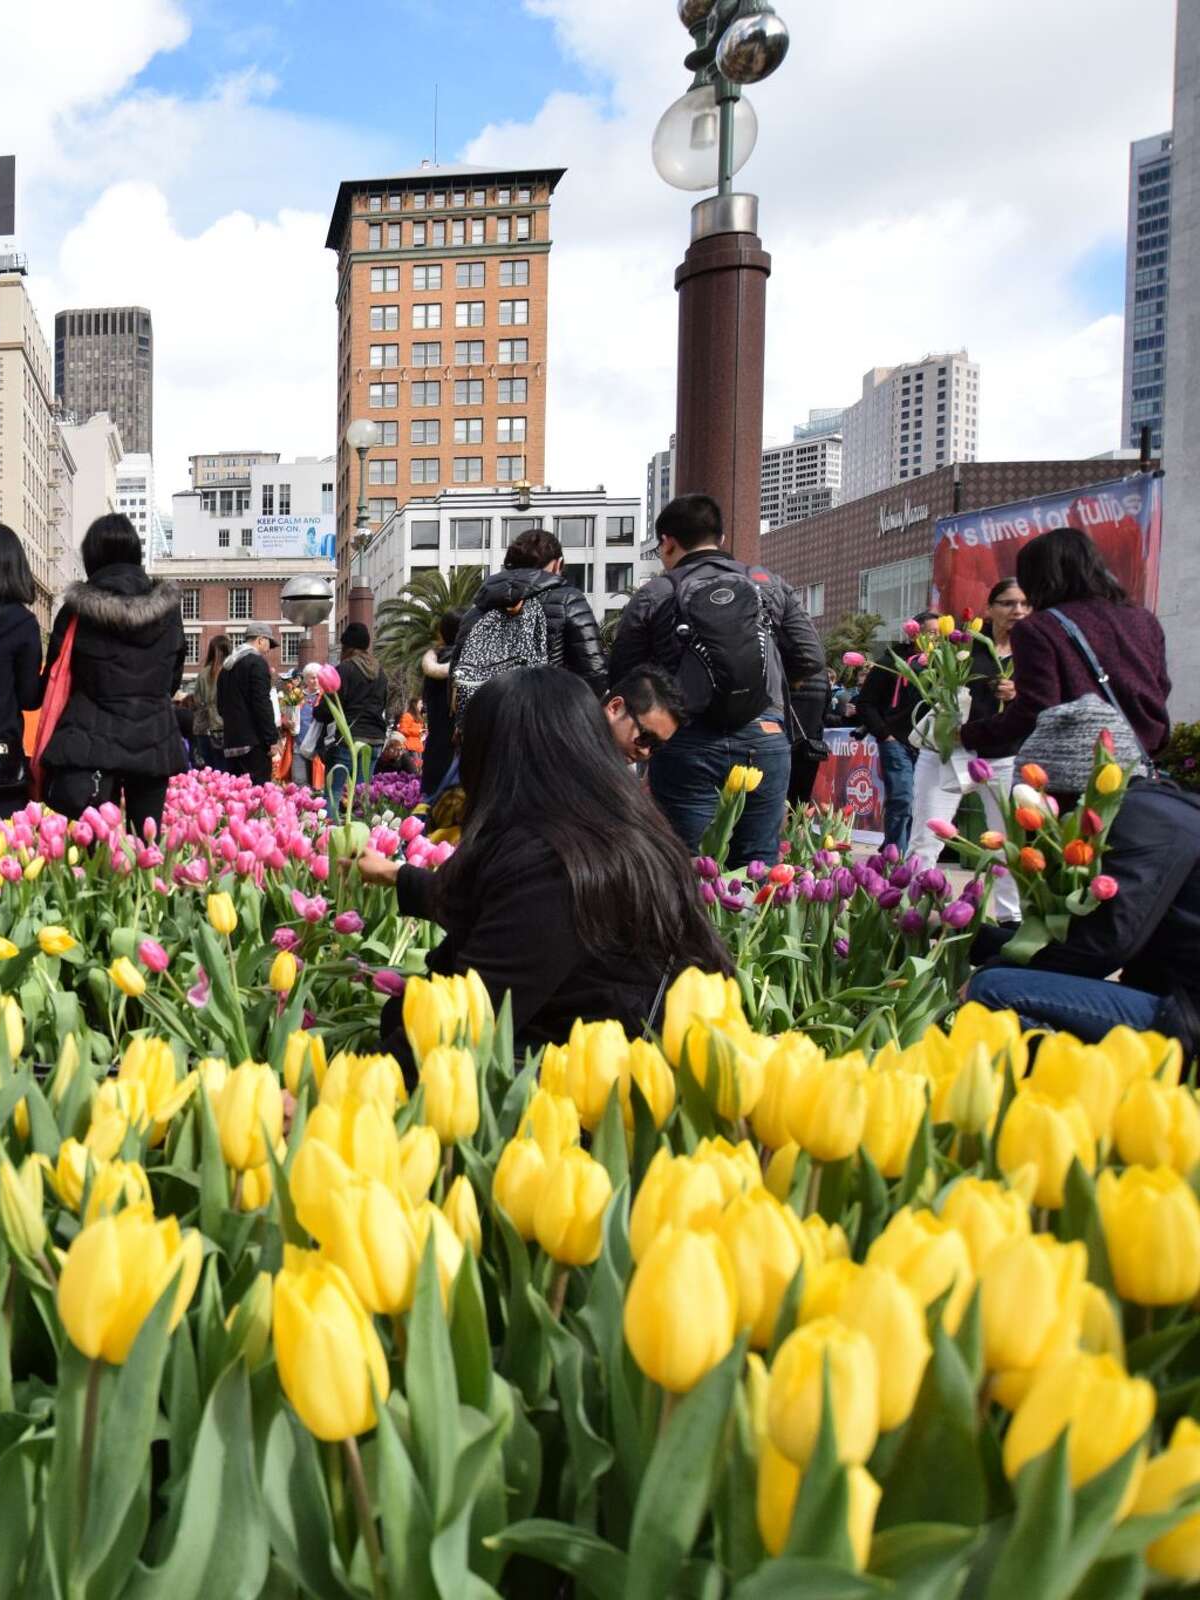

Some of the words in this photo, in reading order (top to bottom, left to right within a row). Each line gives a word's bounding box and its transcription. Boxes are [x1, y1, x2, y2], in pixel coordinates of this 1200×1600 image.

[981, 517, 1030, 549] time
[1033, 506, 1071, 533] for
[1078, 494, 1142, 529] tulips
[832, 737, 859, 756] time
